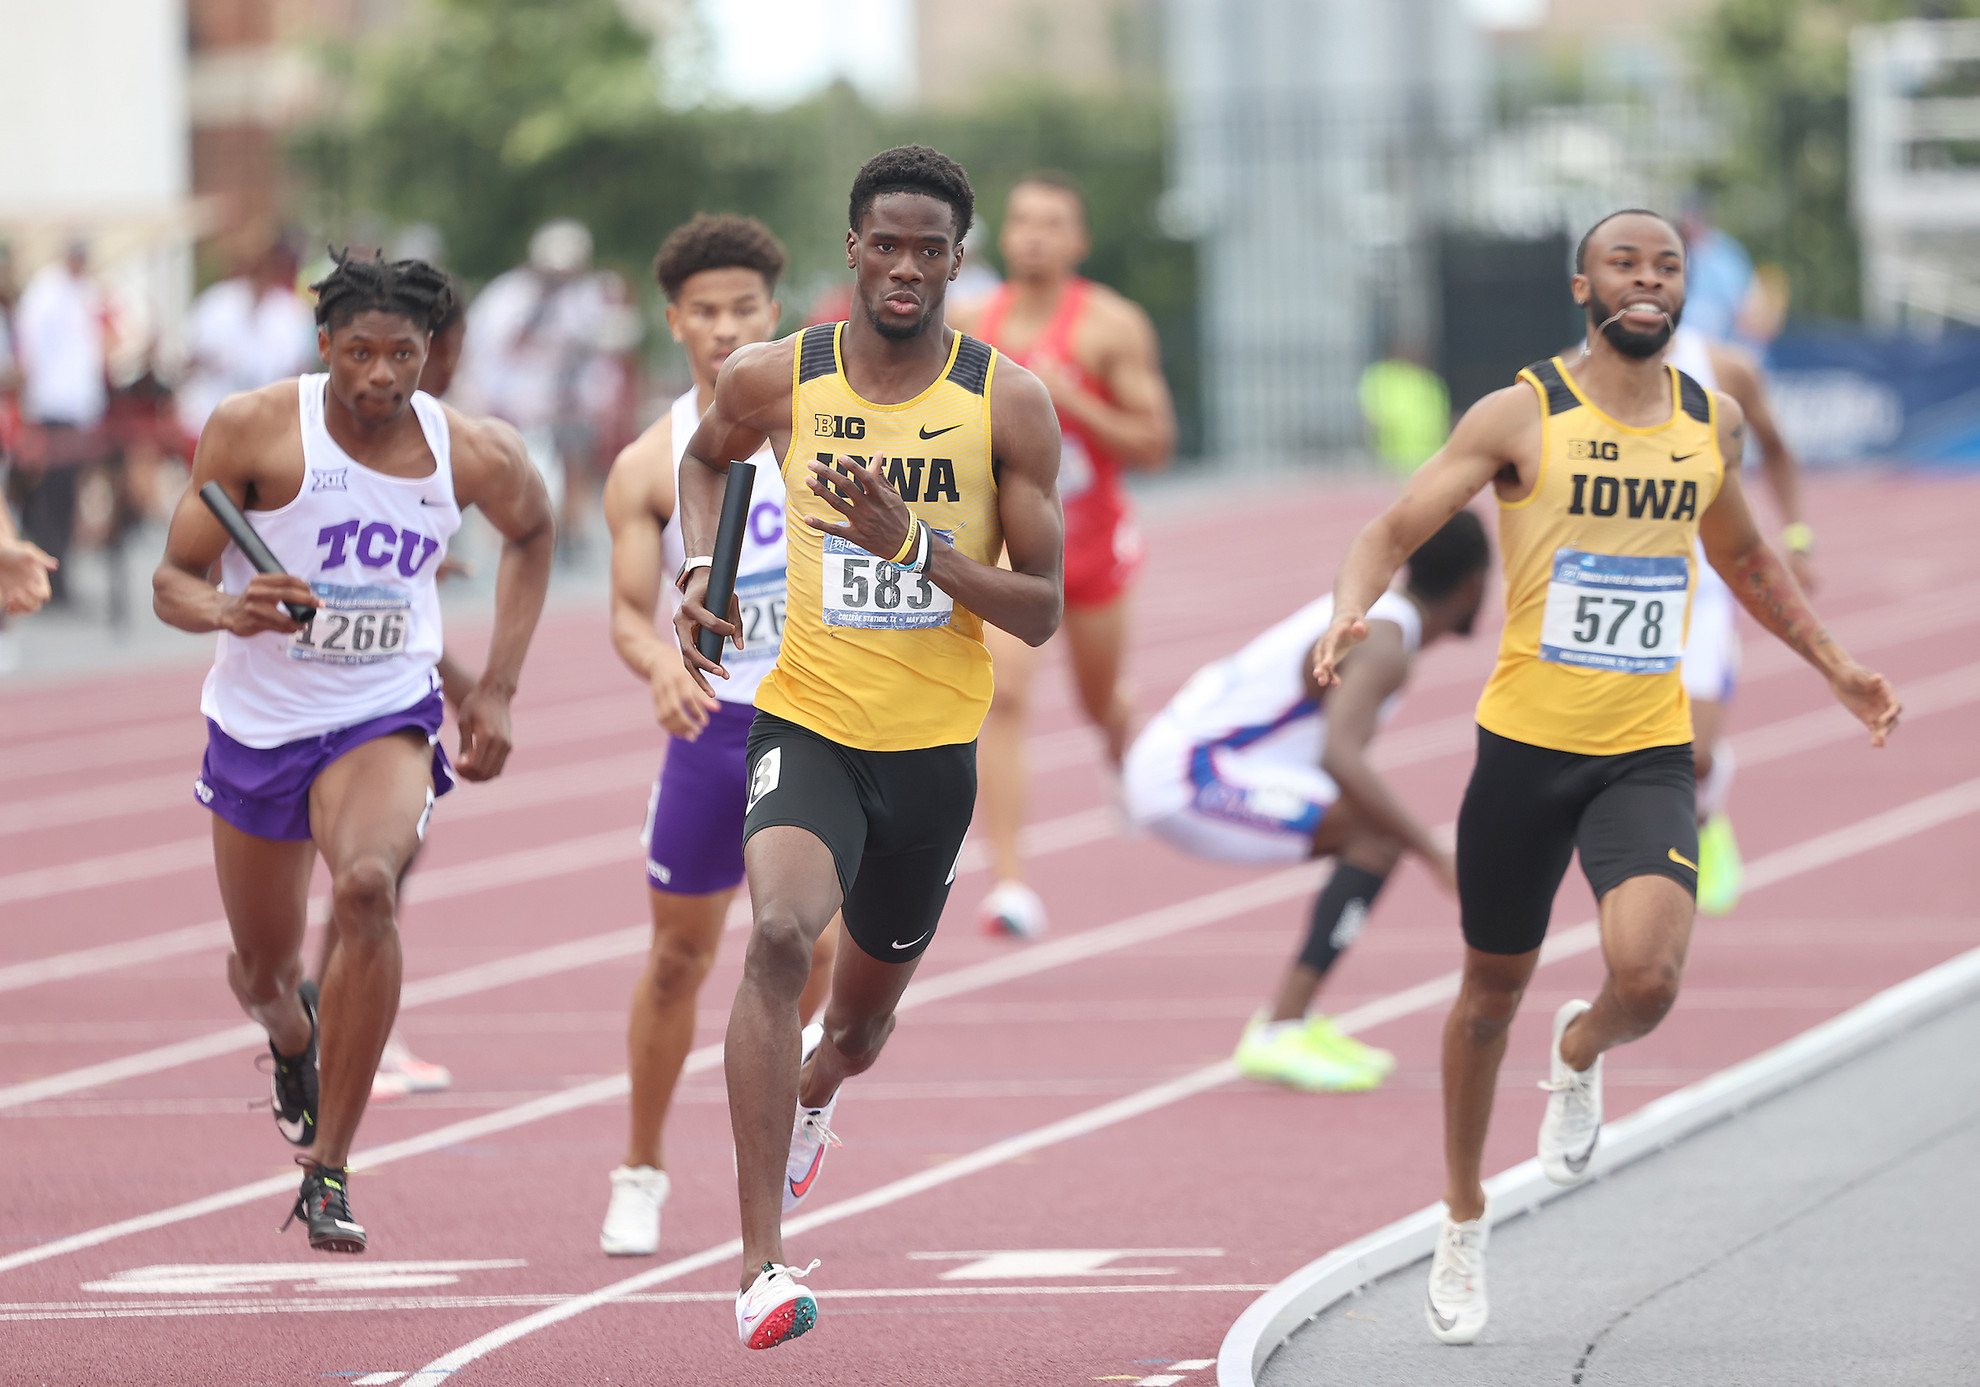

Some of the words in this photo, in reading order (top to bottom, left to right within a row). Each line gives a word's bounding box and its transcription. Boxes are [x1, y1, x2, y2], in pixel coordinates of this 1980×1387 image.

[1568, 474, 1697, 521] IOWA
[317, 520, 439, 578] TCU
[843, 558, 933, 610] 583
[296, 612, 404, 651] 1266
[1573, 596, 1664, 649] 578
